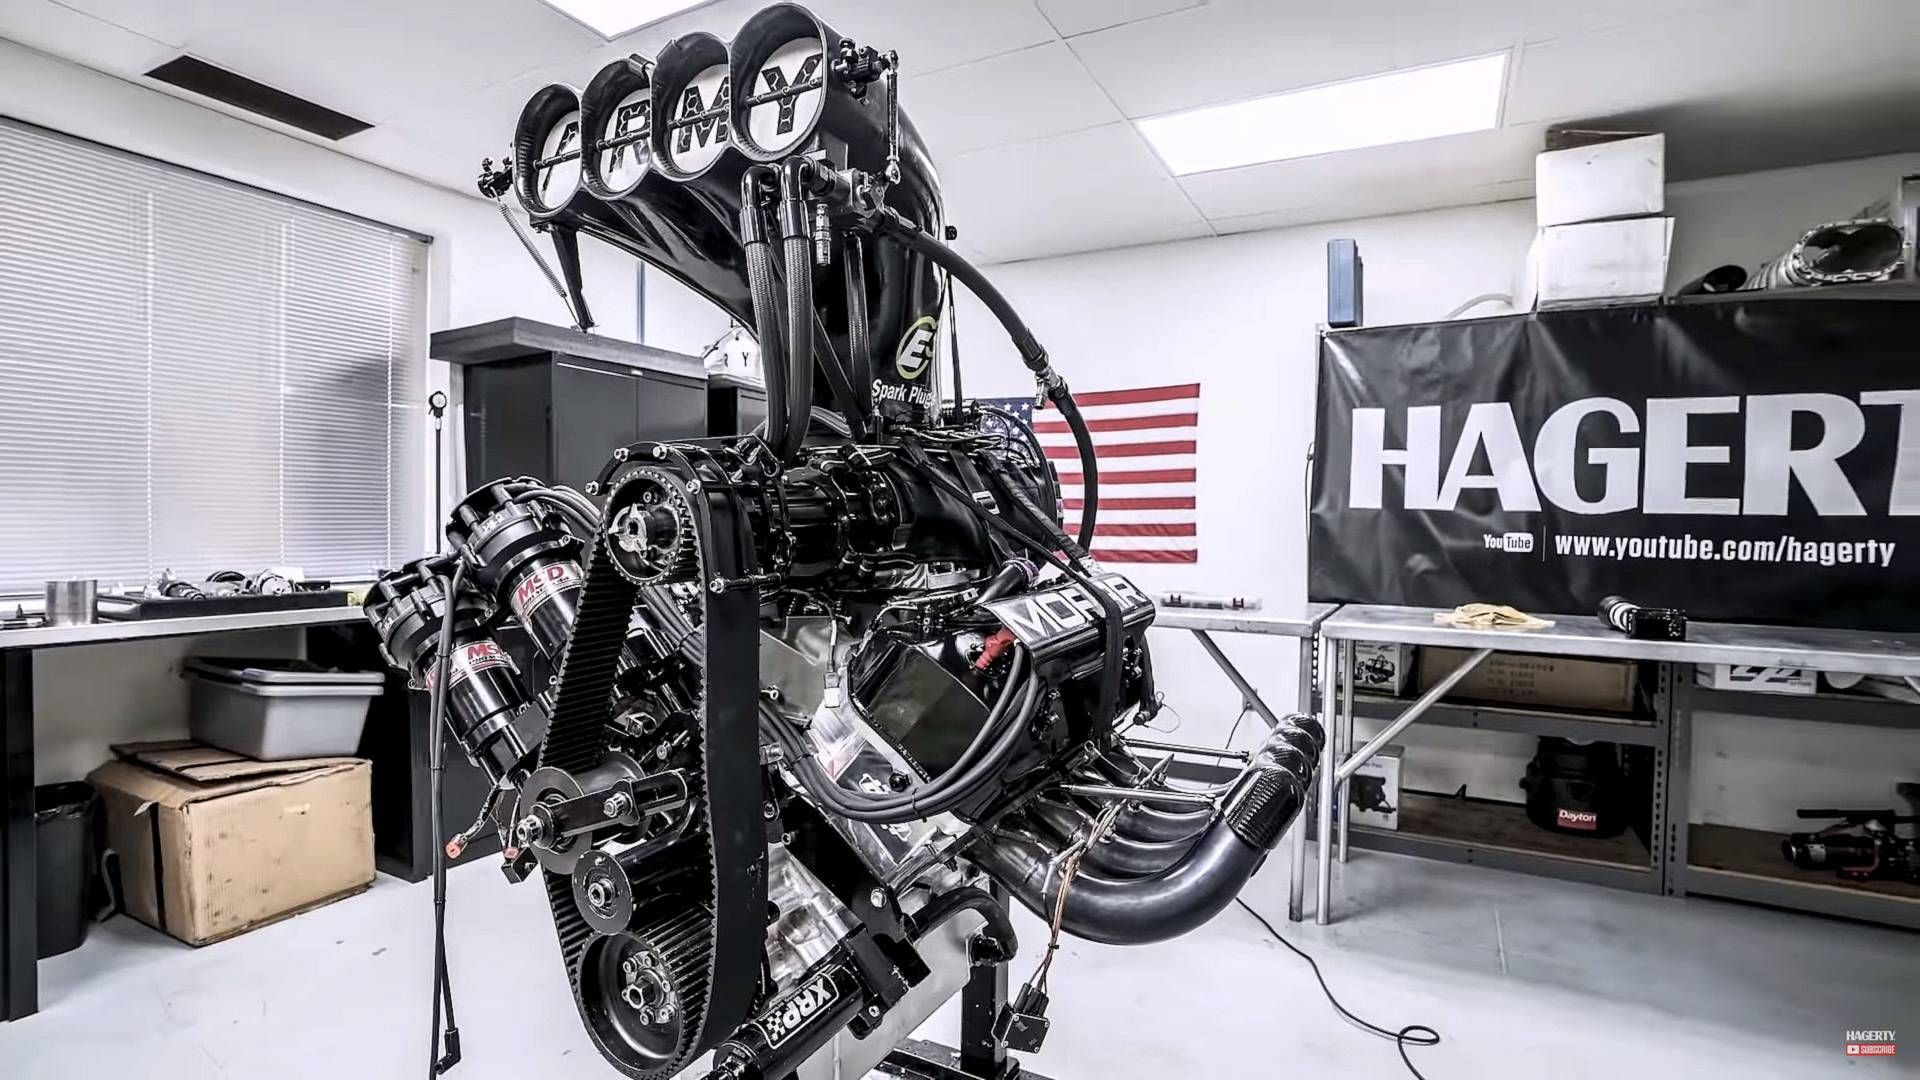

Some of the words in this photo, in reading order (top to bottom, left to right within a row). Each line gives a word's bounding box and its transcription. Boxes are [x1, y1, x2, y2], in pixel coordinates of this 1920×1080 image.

[872, 379, 908, 404] Spark
[908, 385, 937, 409] Plug
[1349, 390, 1920, 516] HAGERT
[1483, 532, 1534, 552] YouTube
[1555, 535, 1896, 567] www.youtube.com/hagerty
[518, 566, 564, 603] MSD
[467, 644, 500, 661] MS
[1559, 809, 1597, 823] Dayton
[783, 978, 832, 1029] XRP
